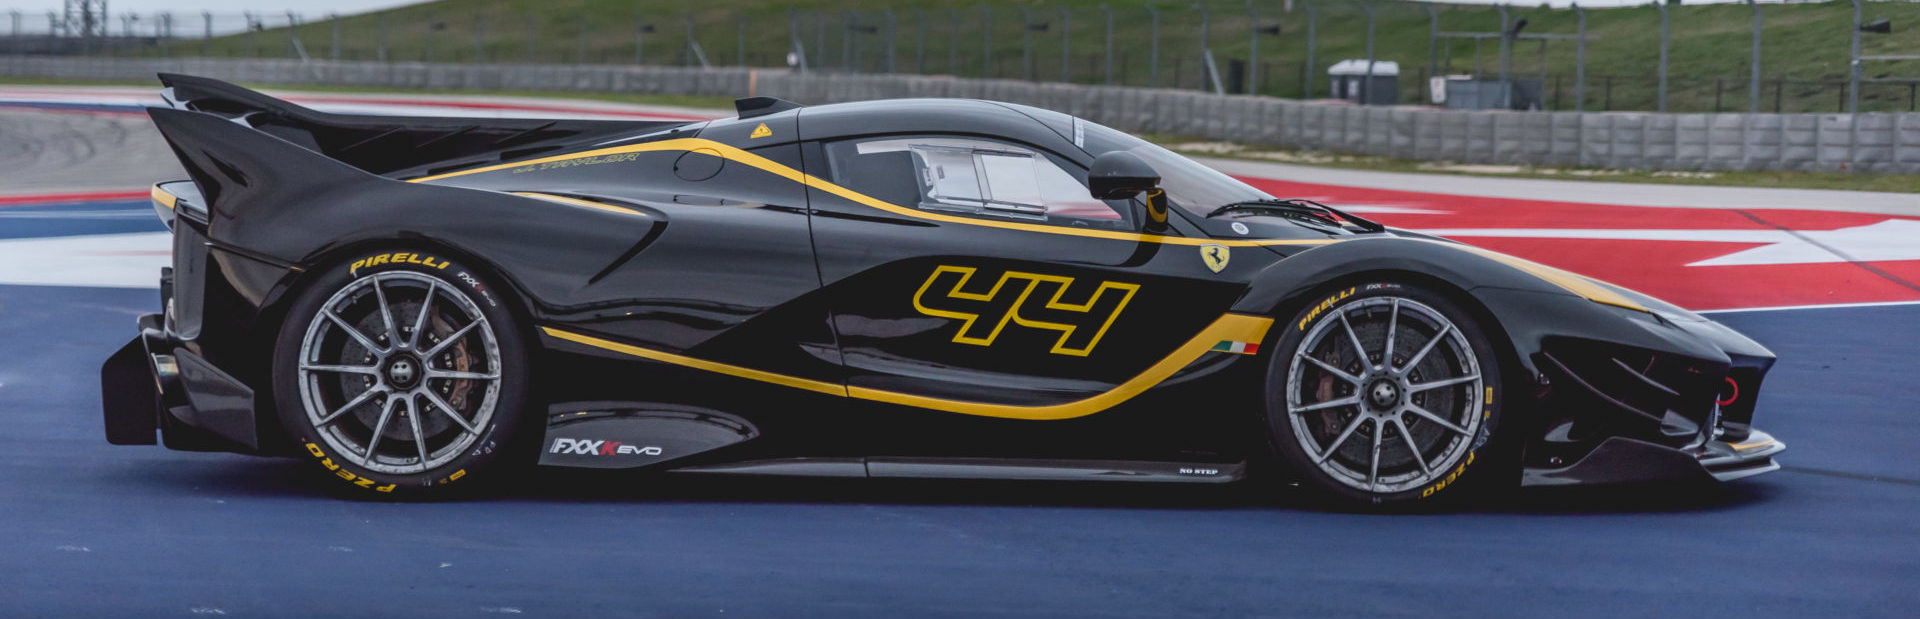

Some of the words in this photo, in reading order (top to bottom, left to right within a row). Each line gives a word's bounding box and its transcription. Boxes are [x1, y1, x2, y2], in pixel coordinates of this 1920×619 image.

[350, 252, 450, 274] PIRELLI
[913, 265, 1141, 357] 44
[1299, 286, 1356, 331] PIRELLI
